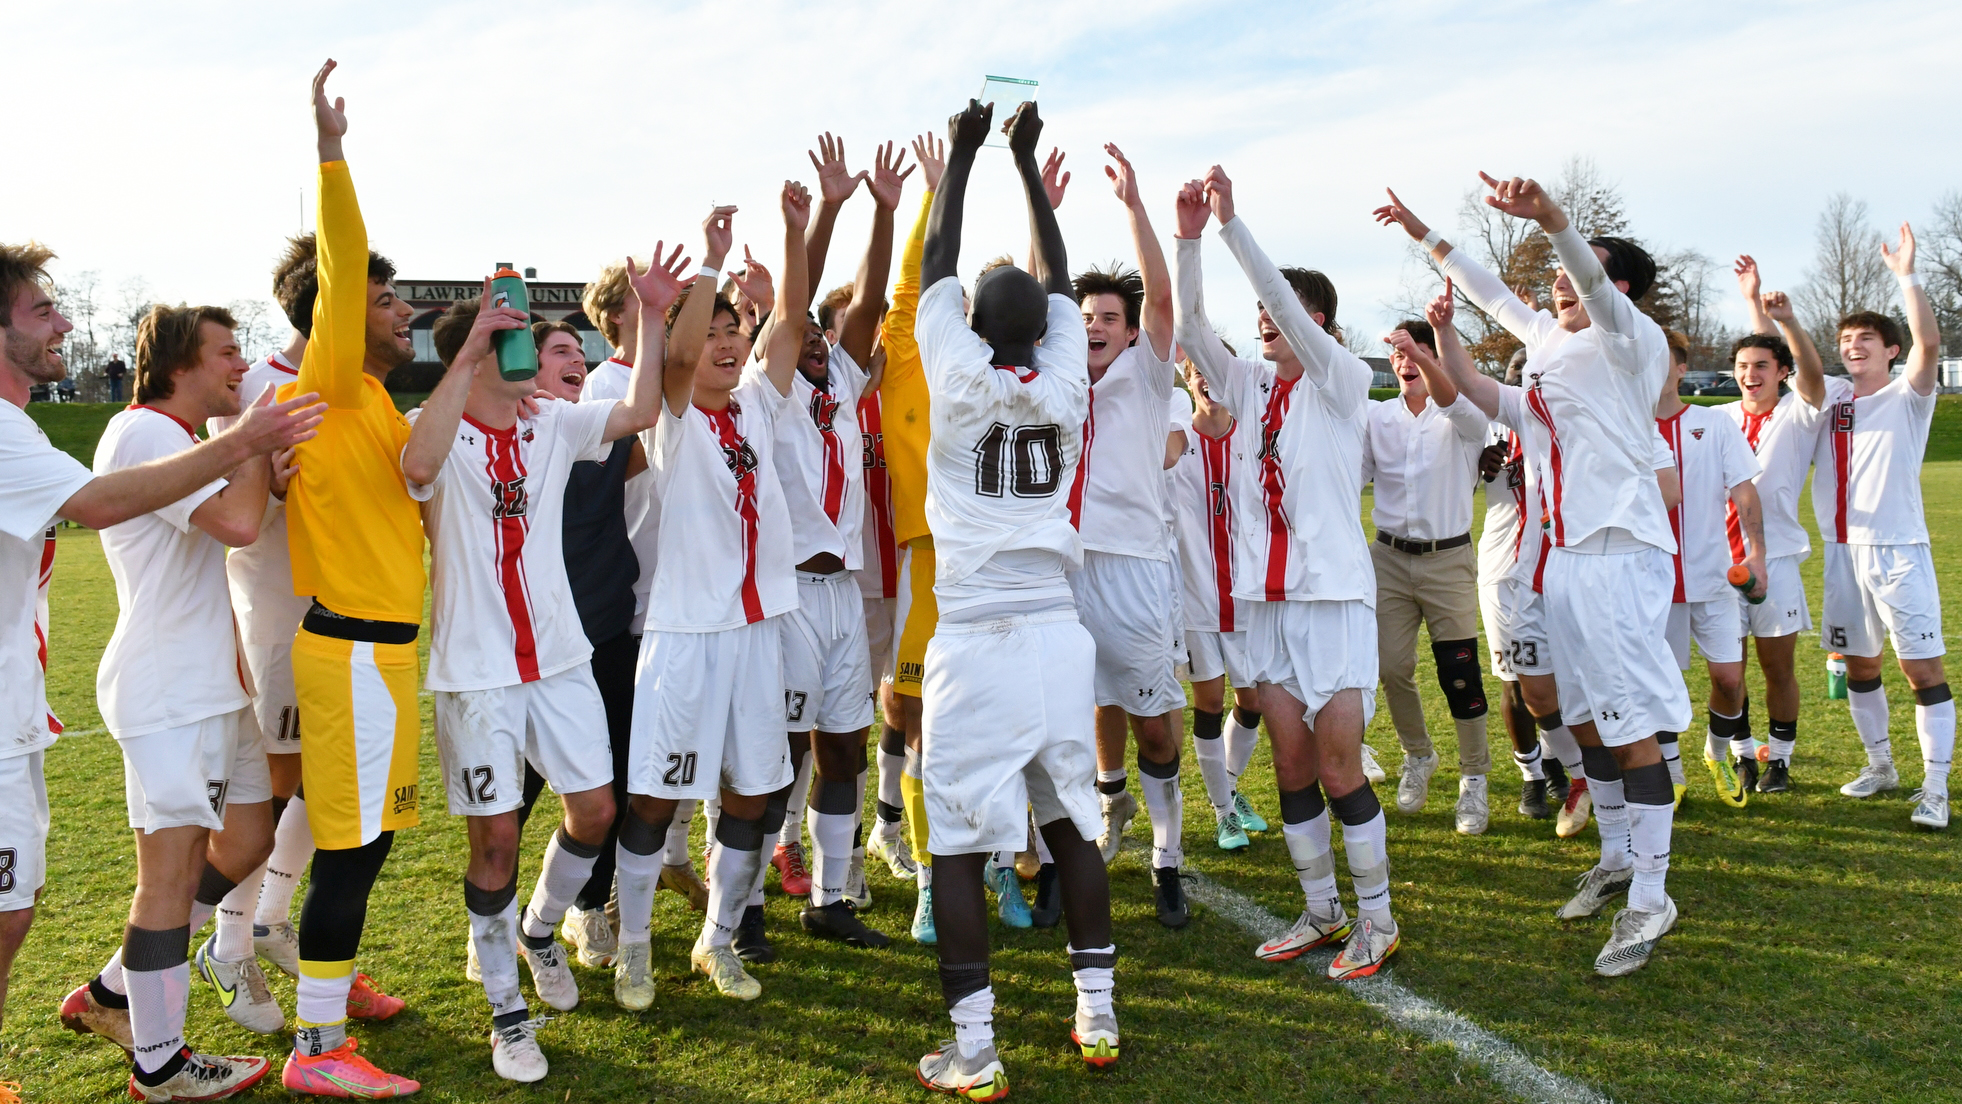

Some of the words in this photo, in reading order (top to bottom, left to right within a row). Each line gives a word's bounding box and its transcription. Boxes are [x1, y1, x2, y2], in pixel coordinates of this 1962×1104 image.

[411, 286, 484, 300] LAWRE
[1830, 401, 1855, 432] 15
[971, 421, 1066, 498] 10
[491, 476, 527, 519] 12
[1211, 482, 1226, 516] 7
[1829, 625, 1848, 648] 15
[1511, 639, 1539, 667] 23
[462, 765, 497, 804] 12
[662, 751, 698, 787] 20
[135, 1036, 180, 1053] SAINTS
